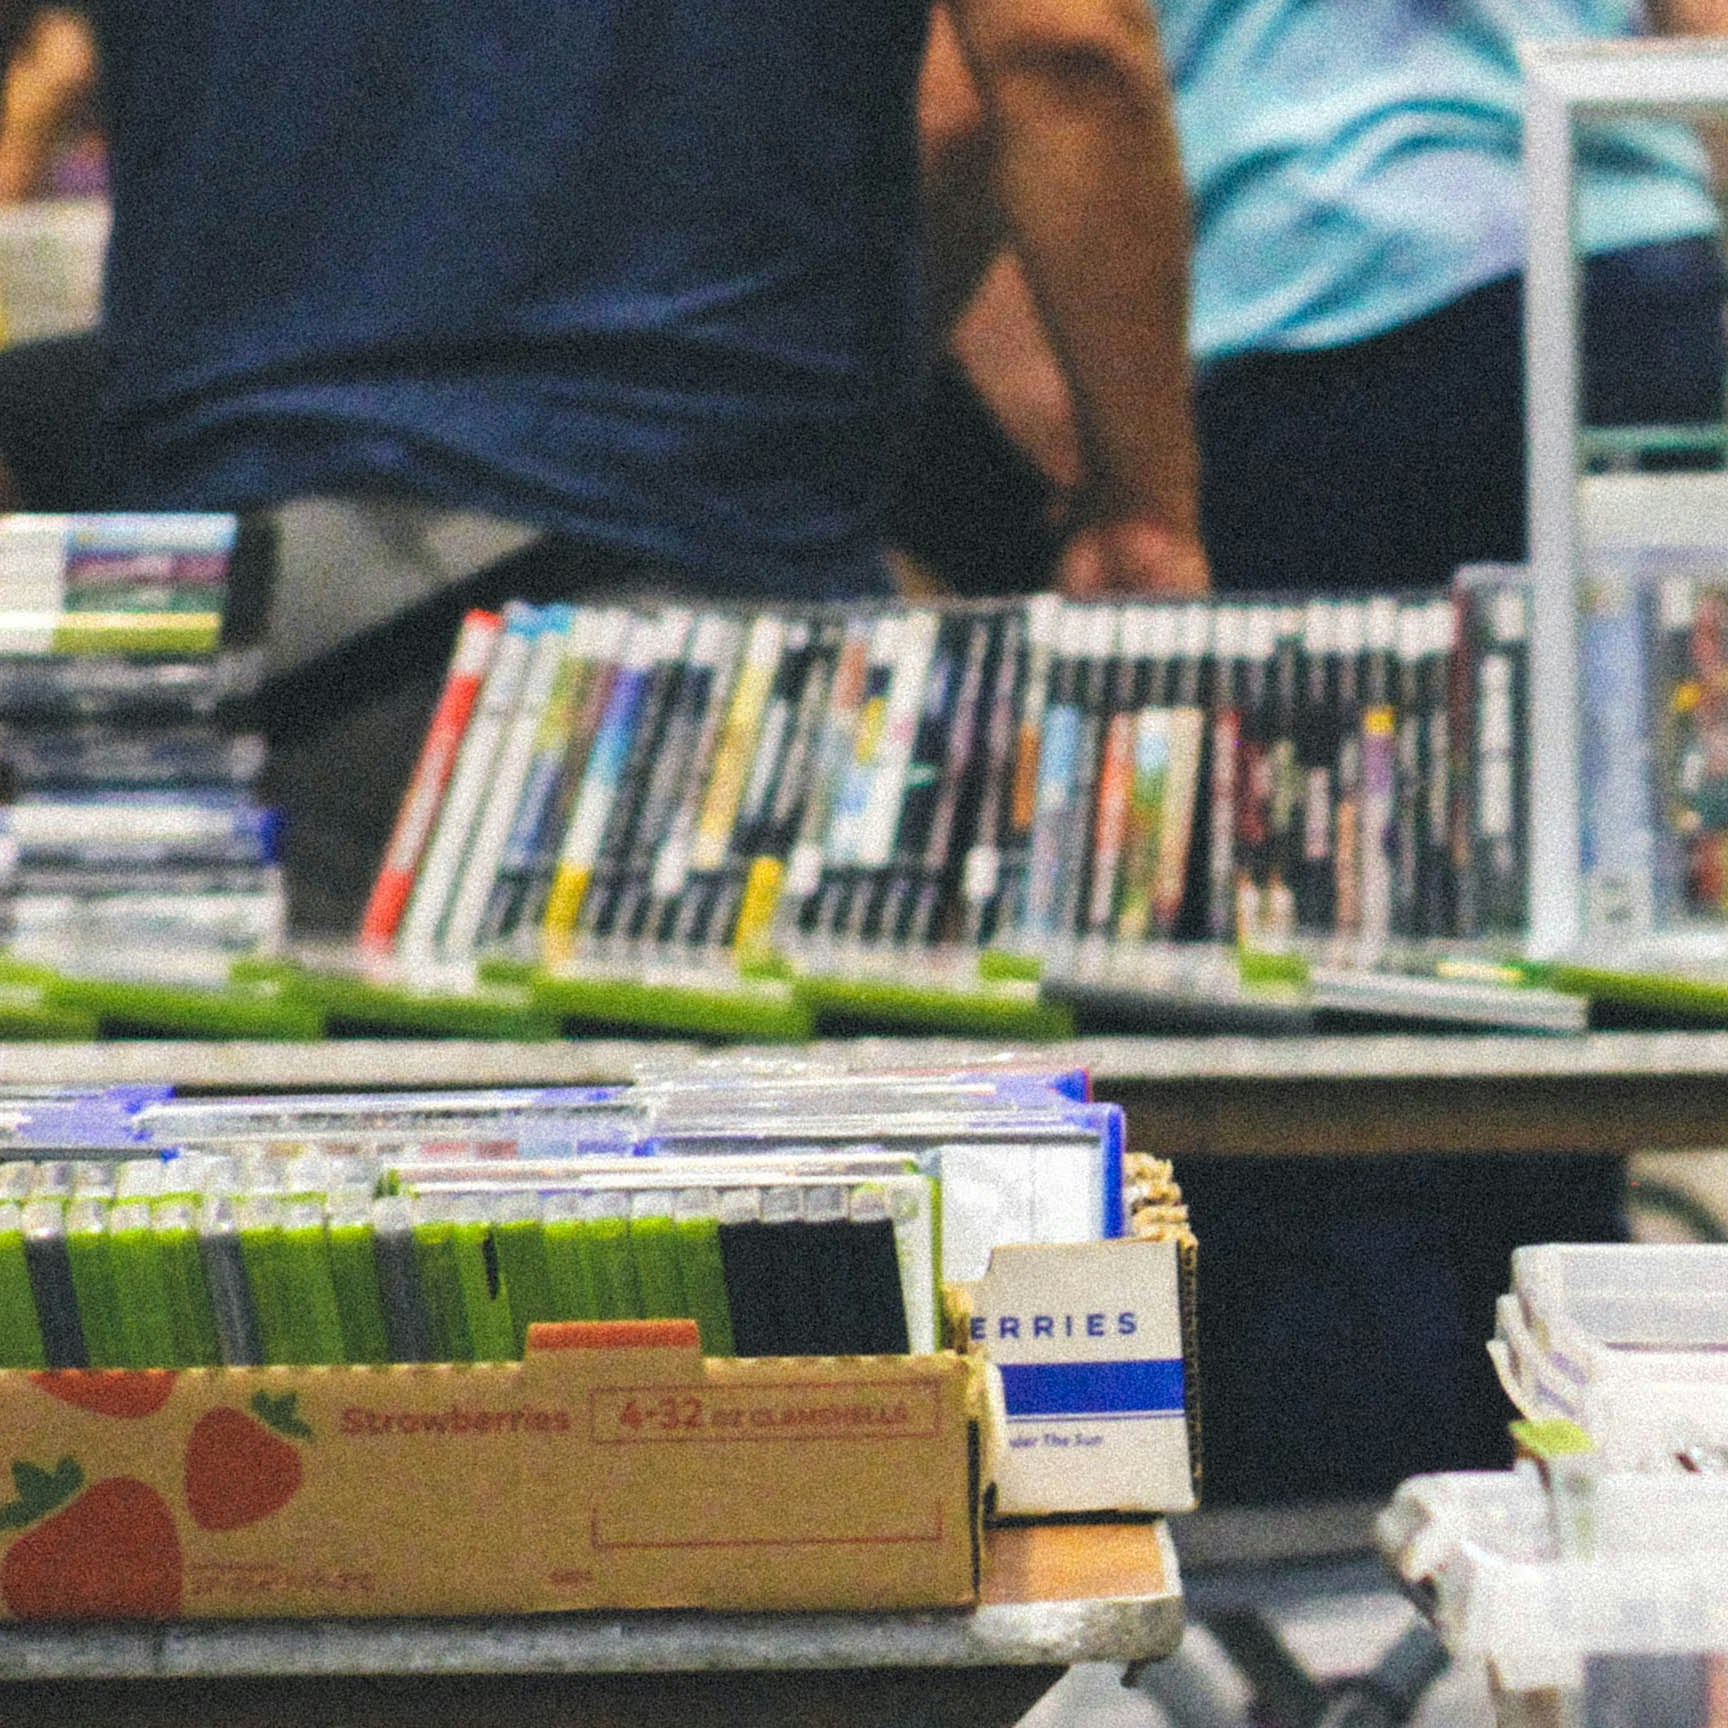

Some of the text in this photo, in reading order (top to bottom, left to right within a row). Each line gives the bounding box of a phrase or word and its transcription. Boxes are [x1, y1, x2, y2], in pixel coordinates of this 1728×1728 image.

[970, 1311, 1137, 1341] ERRIES
[341, 1402, 571, 1437] Strawberries
[619, 1398, 703, 1431] 4-32
